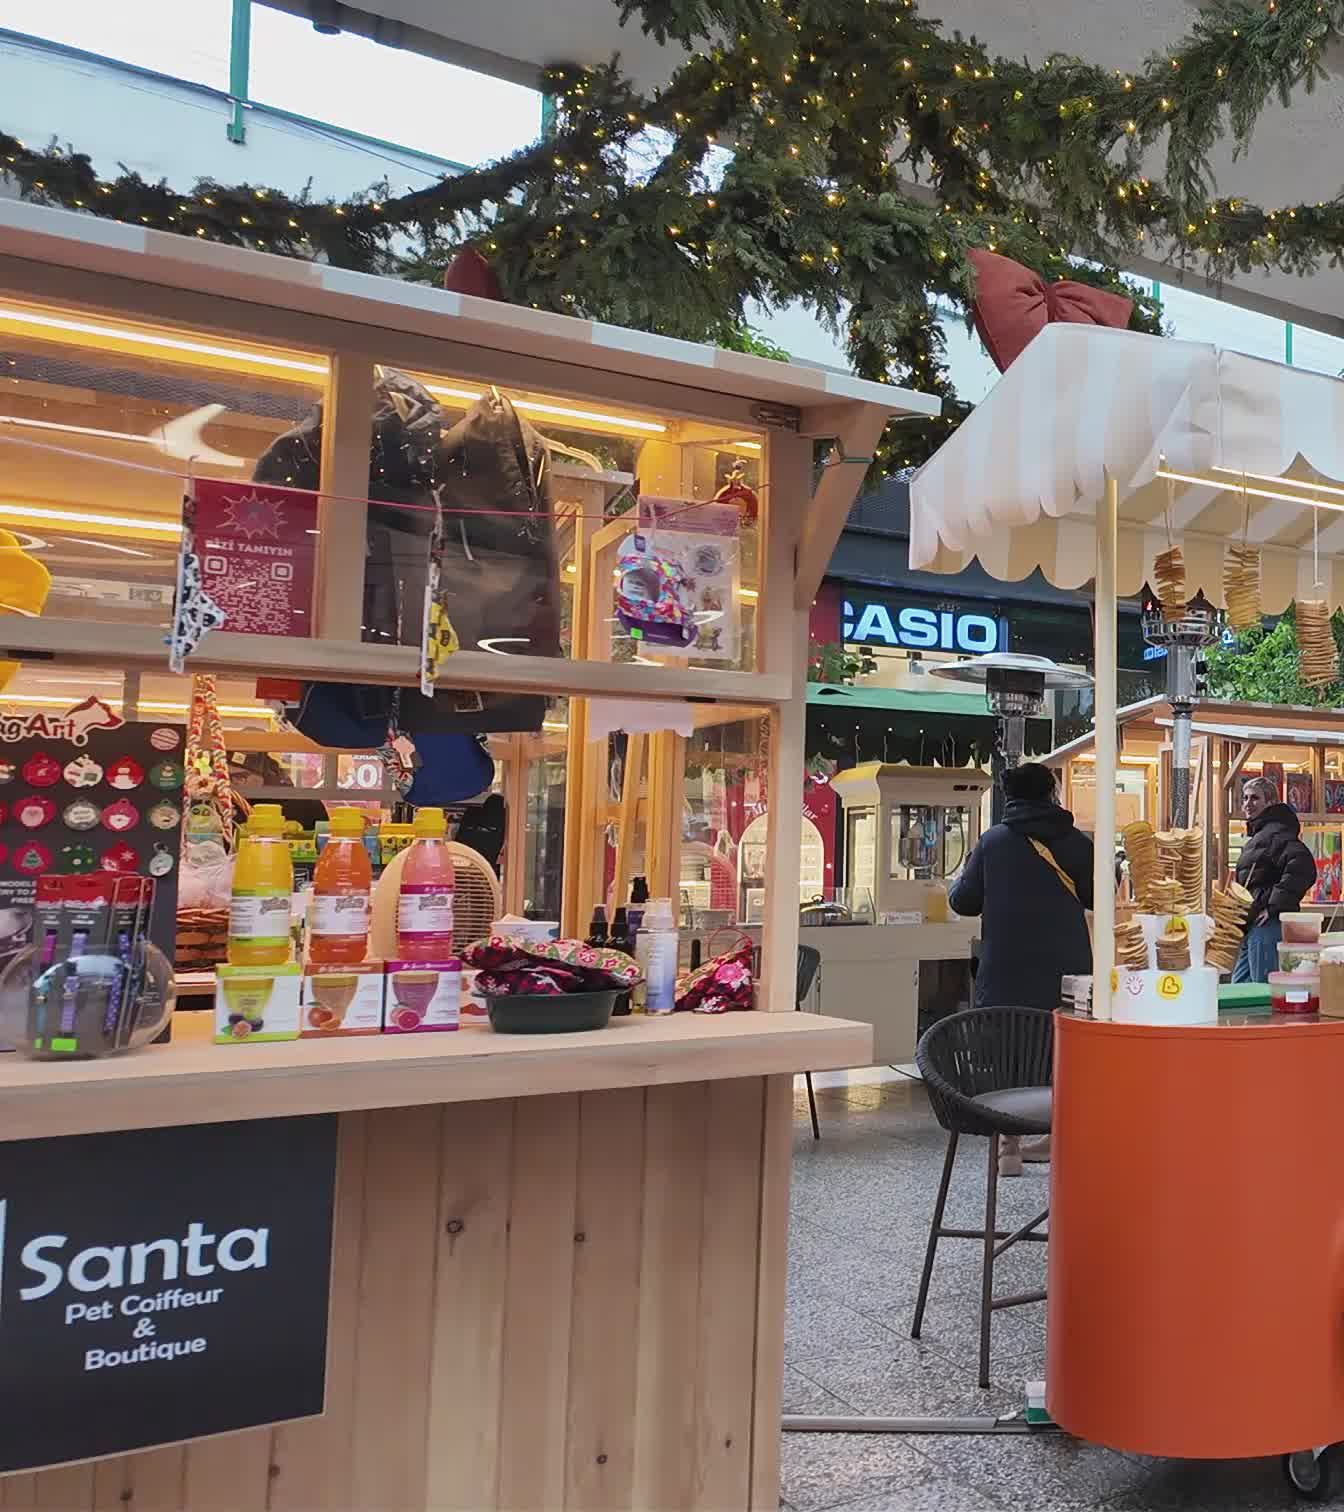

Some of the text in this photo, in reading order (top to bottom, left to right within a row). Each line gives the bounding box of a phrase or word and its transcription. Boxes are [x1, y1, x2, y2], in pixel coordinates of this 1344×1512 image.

[843, 601, 997, 653] ASIO
[19, 1222, 269, 1300] Santa
[64, 1288, 225, 1325] Pet Coiffeur
[132, 1317, 156, 1338] &
[84, 1337, 207, 1371] Boutique
